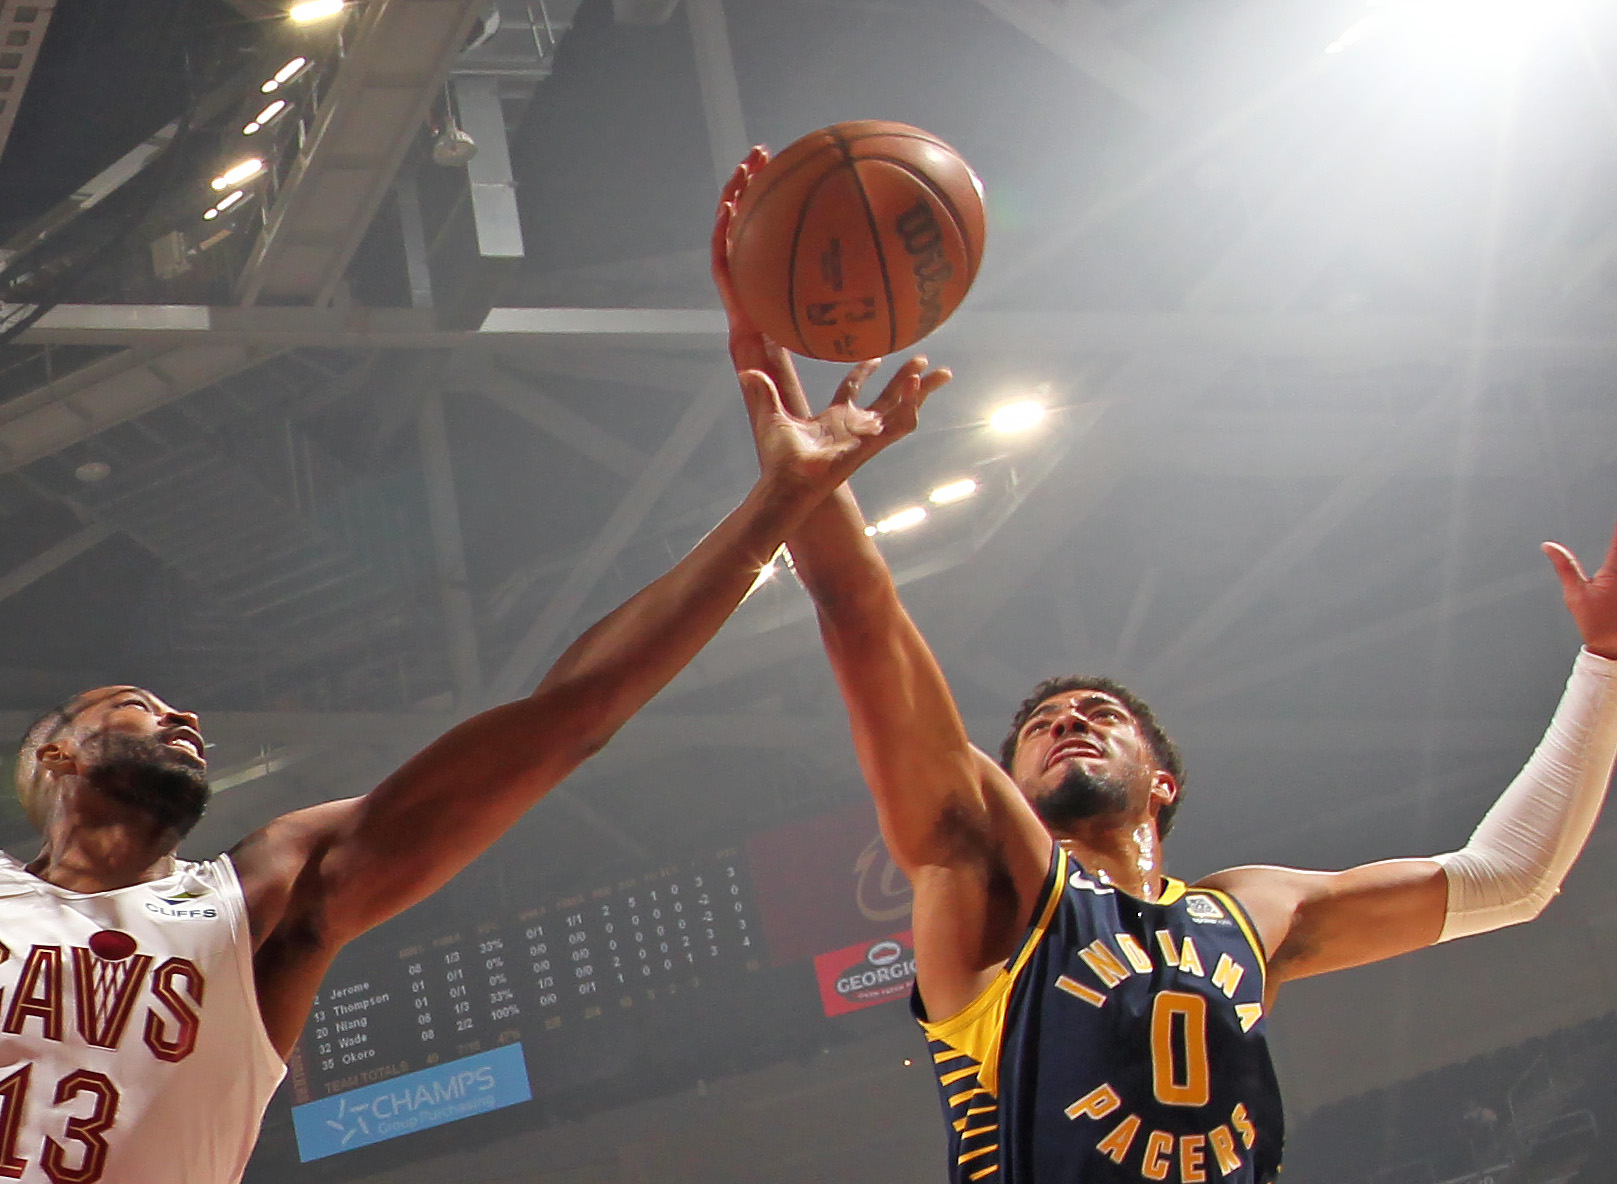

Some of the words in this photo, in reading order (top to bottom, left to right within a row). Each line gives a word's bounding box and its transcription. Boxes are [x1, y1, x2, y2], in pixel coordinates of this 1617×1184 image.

[145, 902, 217, 918] CLIFFS
[330, 981, 370, 1001] Jerome
[444, 952, 461, 965] 1/3
[670, 884, 679, 895] 0
[333, 992, 390, 1017] Thompson
[605, 922, 614, 934] 0
[631, 914, 640, 926] 0
[653, 908, 661, 920] 0
[674, 902, 683, 913] 0
[730, 884, 739, 896] 0
[316, 1027, 329, 1040] 20
[609, 939, 617, 951] 0
[635, 931, 643, 942] 0
[656, 925, 665, 937] 0
[734, 902, 743, 913] 0
[319, 1043, 332, 1055] 32
[338, 1033, 368, 1049] Wade
[638, 948, 647, 959] 0
[660, 942, 668, 953] 0
[342, 1047, 376, 1066] Okoro
[490, 1004, 520, 1021] 100%
[642, 965, 651, 977] 0
[664, 959, 672, 971] 0
[1054, 929, 1265, 1034] INDIANA
[372, 1065, 496, 1119] CHAMPS
[1150, 989, 1210, 1108] 0
[378, 1114, 418, 1135] Group
[1064, 1083, 1256, 1184] PACERS
